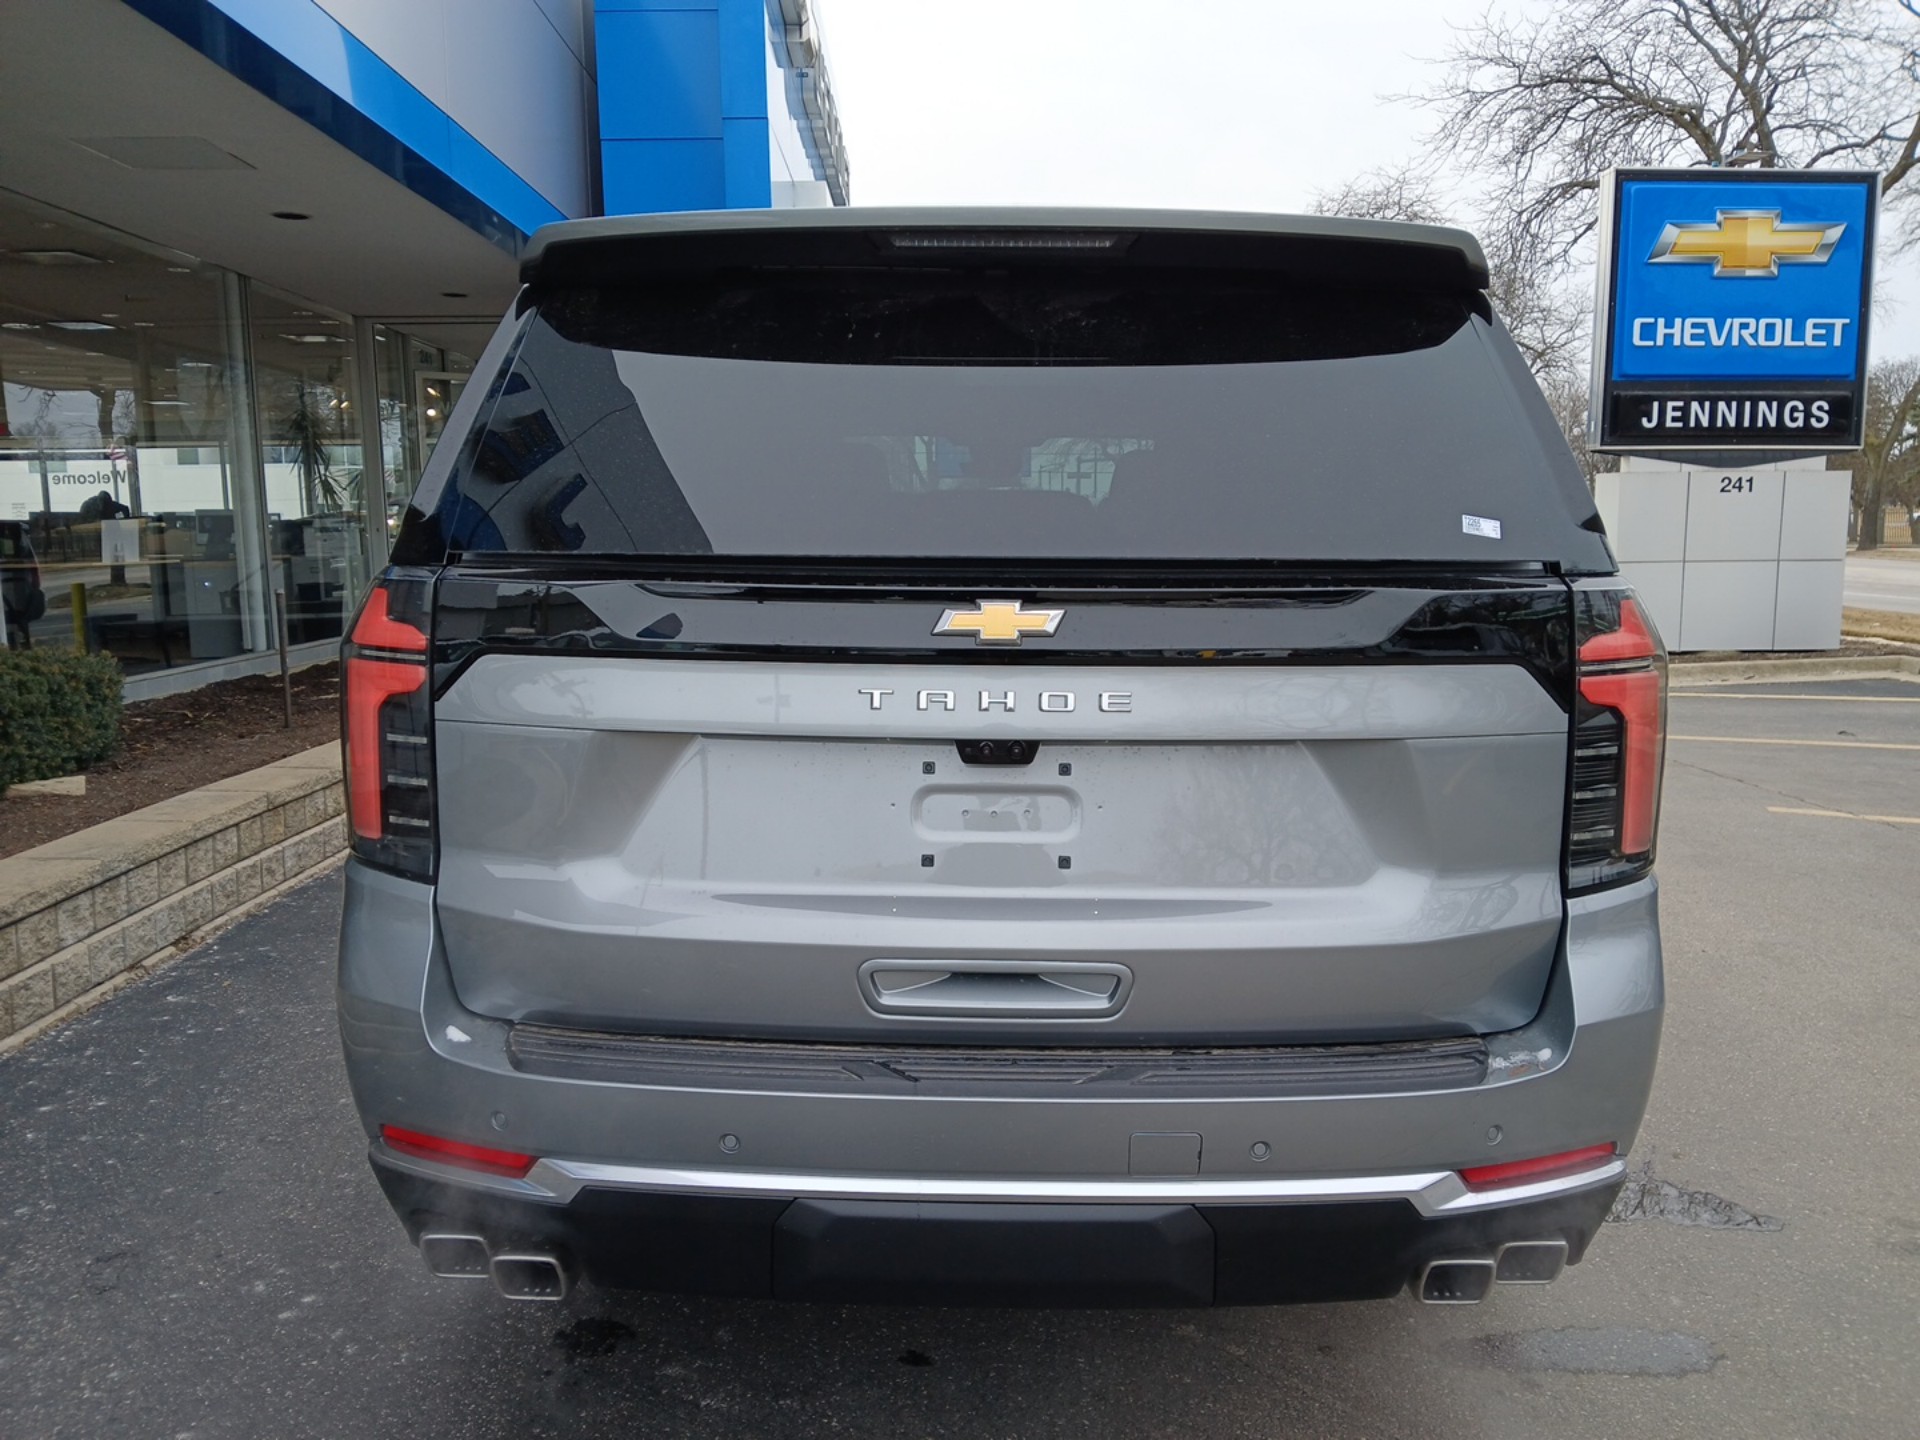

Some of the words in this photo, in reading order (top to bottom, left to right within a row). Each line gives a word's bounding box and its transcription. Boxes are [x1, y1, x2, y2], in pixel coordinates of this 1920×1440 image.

[1632, 317, 1850, 347] CHEVROLET
[1641, 400, 1830, 428] JENNINGS
[1720, 476, 1754, 493] 241
[858, 689, 1132, 712] TAHOE
